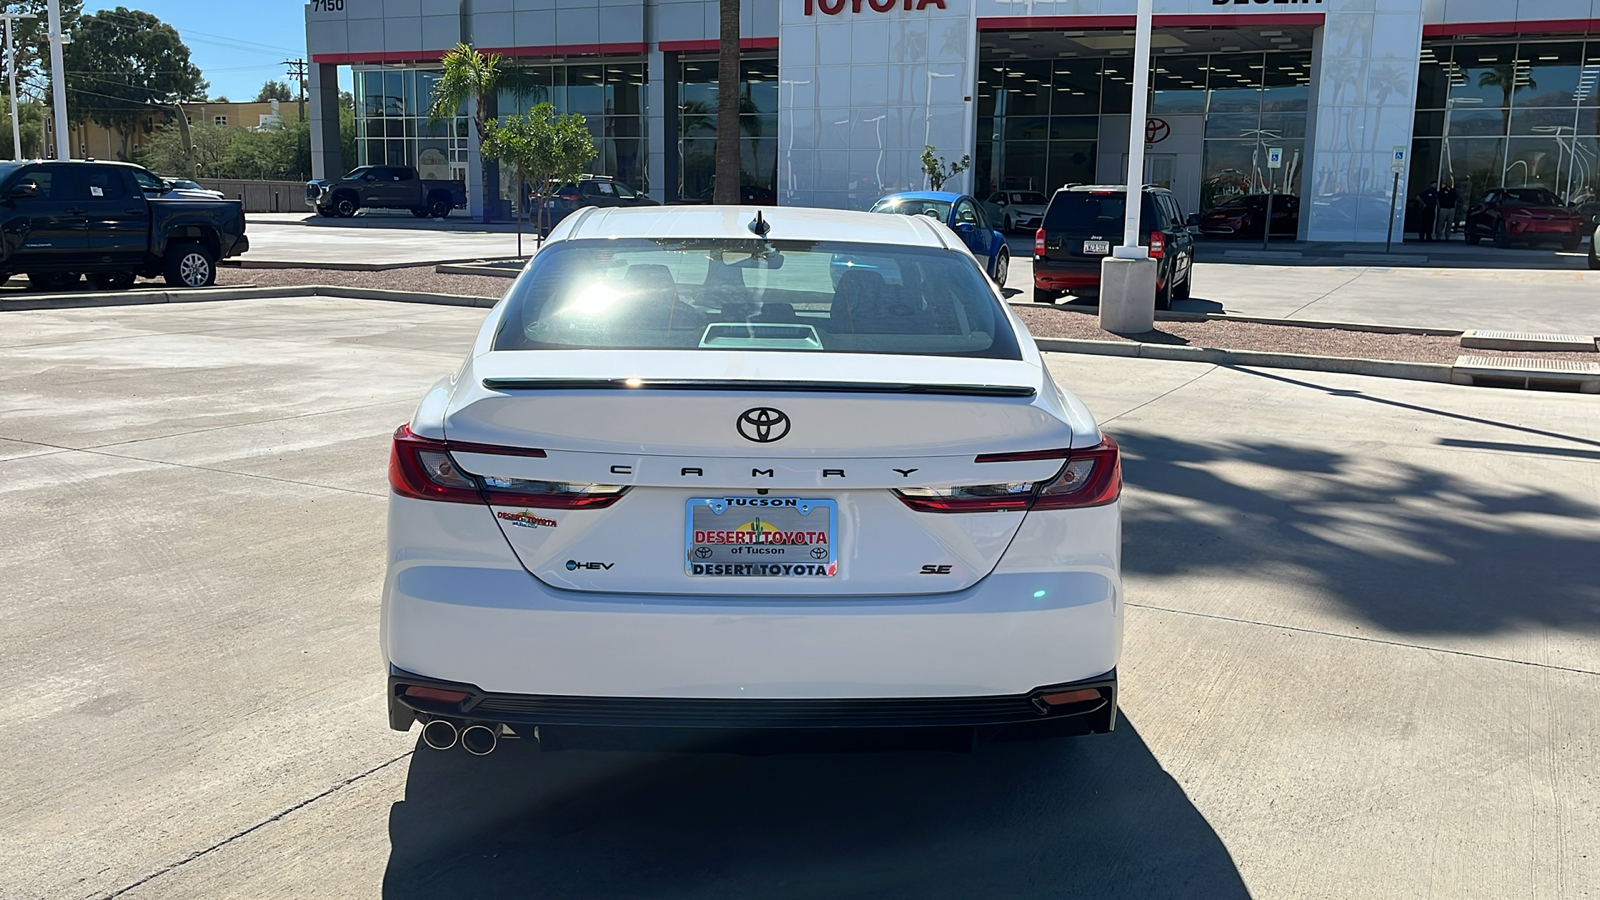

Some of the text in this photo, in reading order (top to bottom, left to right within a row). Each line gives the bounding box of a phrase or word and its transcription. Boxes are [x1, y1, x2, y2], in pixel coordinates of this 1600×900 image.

[313, 0, 344, 12] 7150
[610, 465, 919, 478] CAMRY
[725, 498, 797, 506] TUCSON
[497, 511, 525, 522] DESERT
[527, 515, 557, 528] TOYOTA
[695, 531, 827, 544] DESERT TOYOTA
[745, 547, 785, 555] Tucson
[693, 564, 827, 575] DESERT TOYOTA
[920, 564, 952, 574] SE
